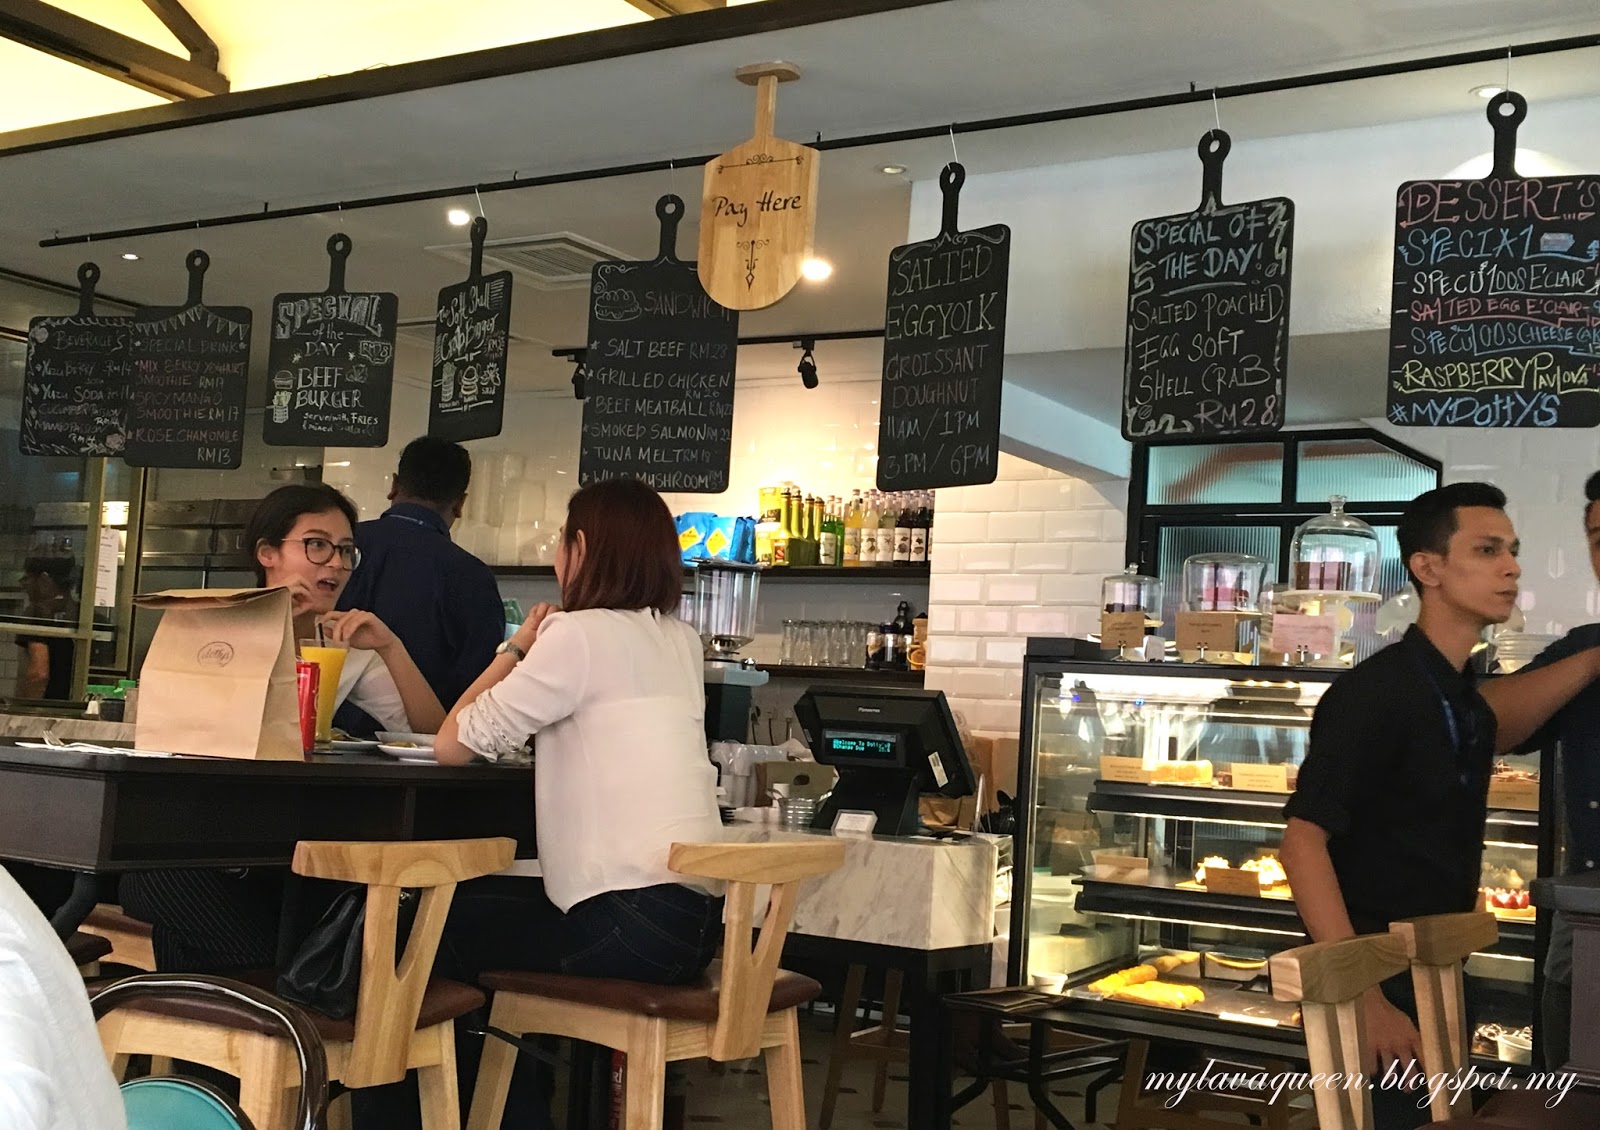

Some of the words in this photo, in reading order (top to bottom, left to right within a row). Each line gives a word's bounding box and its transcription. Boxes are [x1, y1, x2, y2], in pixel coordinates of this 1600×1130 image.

[713, 196, 748, 227] Pay
[756, 191, 803, 212] Here
[1137, 220, 1221, 254] SPECIAL
[1229, 206, 1266, 241] OF
[892, 245, 993, 296] SALTED
[1158, 252, 1200, 281] THE
[1202, 243, 1264, 278] DAY!
[1132, 300, 1197, 331] SALTED
[1487, 298, 1520, 315] EGG
[312, 323, 325, 341] of
[327, 323, 344, 340] the
[140, 337, 195, 352] SPECIAL
[201, 340, 239, 354] DRINK
[304, 341, 342, 357] DAY
[605, 338, 643, 358] SALT
[648, 341, 686, 358] BEEF
[1136, 334, 1180, 371] EGG
[1188, 327, 1245, 362] SOFT
[138, 360, 158, 373] MIX
[886, 344, 990, 381] CROISSANT
[137, 374, 192, 388] SMOOTHIE
[297, 366, 344, 389] BEEF
[597, 367, 664, 388] GRILLED
[668, 372, 731, 389] CHICKEN
[1135, 369, 1194, 405] SHELL
[1201, 354, 1271, 395] CRAB
[294, 389, 364, 410] BURGER
[893, 378, 979, 408] DOUGHNUT
[136, 407, 206, 421] SMOOTHIE
[595, 396, 634, 414] BEEF
[634, 399, 707, 417] MEATBALL
[350, 412, 379, 426] FRIES
[136, 428, 173, 443] ROSE
[590, 424, 646, 439] SMOKED
[650, 424, 707, 441] SALMON
[594, 446, 632, 461] TUNA
[638, 447, 683, 463] MELT
[636, 472, 708, 490] MUSHROOM
